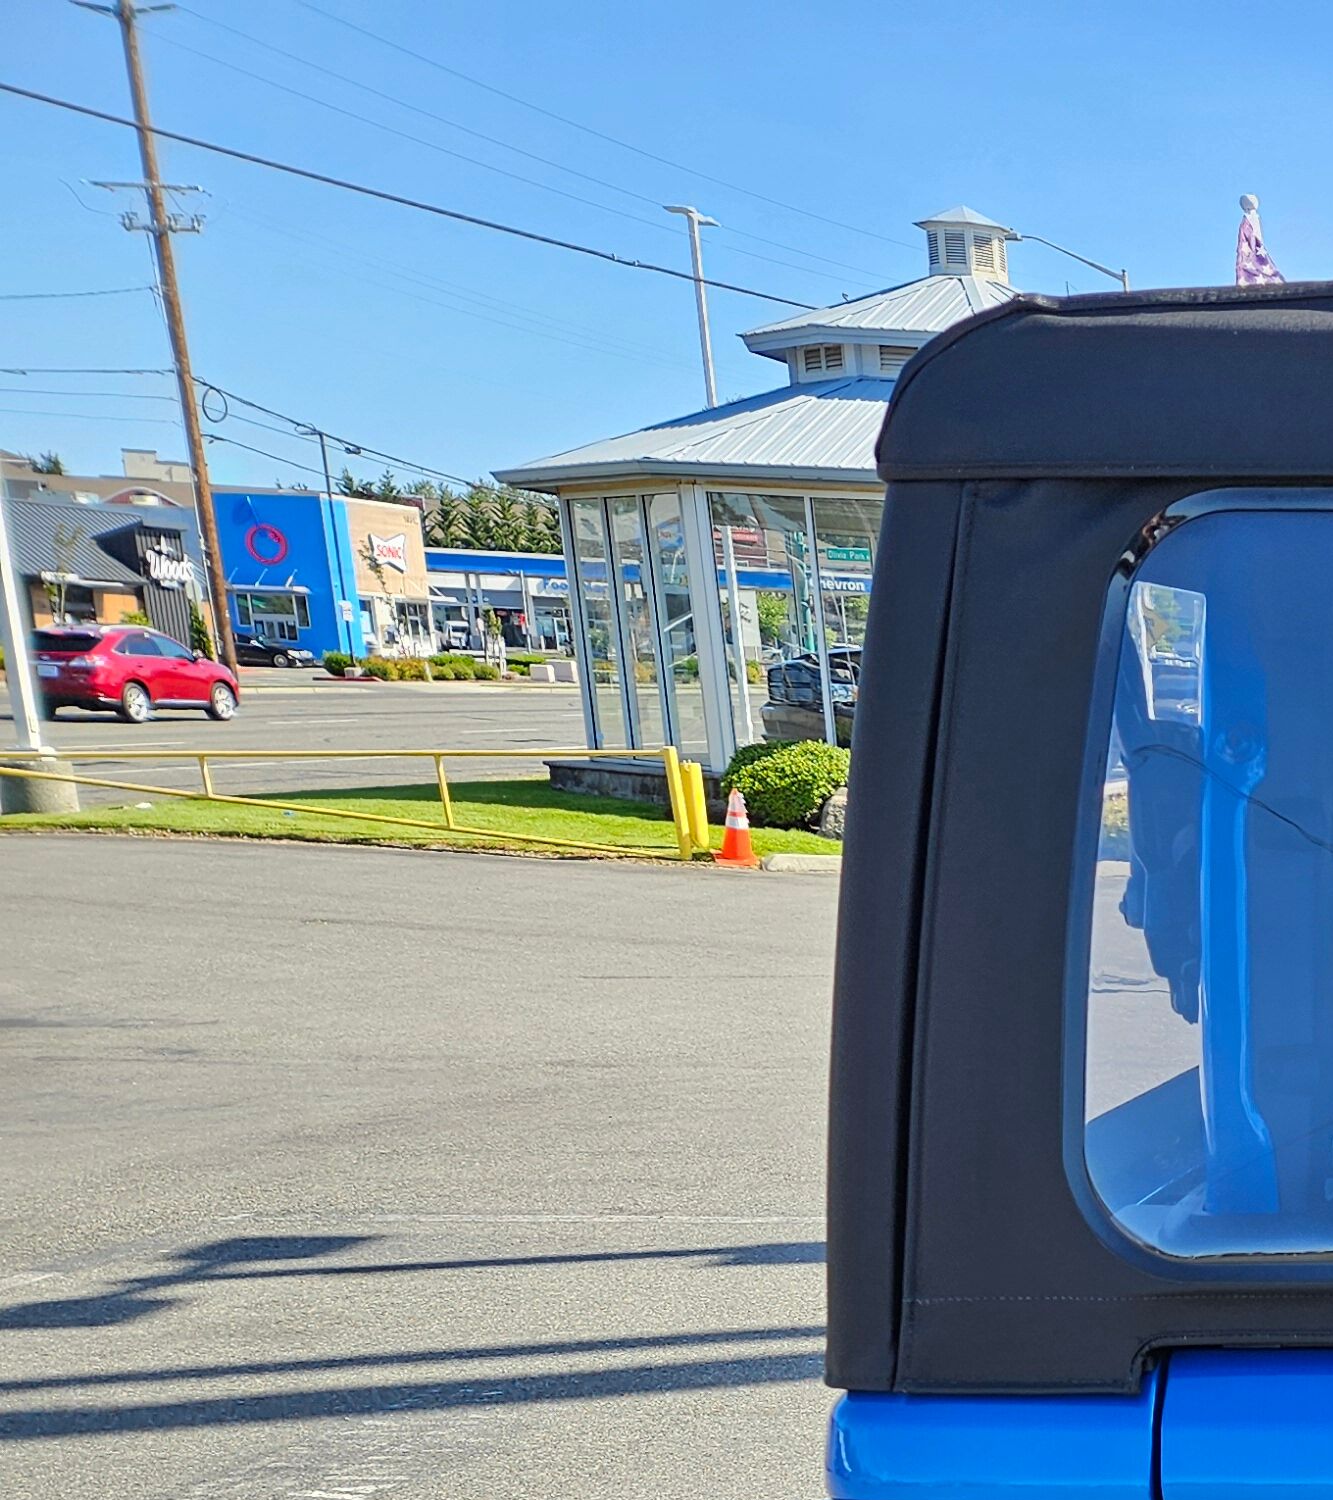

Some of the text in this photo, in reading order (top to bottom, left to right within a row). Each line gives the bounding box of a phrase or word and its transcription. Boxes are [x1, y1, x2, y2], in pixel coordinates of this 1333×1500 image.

[376, 544, 402, 560] SONIC
[828, 550, 847, 559] Olivia
[849, 550, 866, 560] Park
[146, 550, 194, 581] Woods
